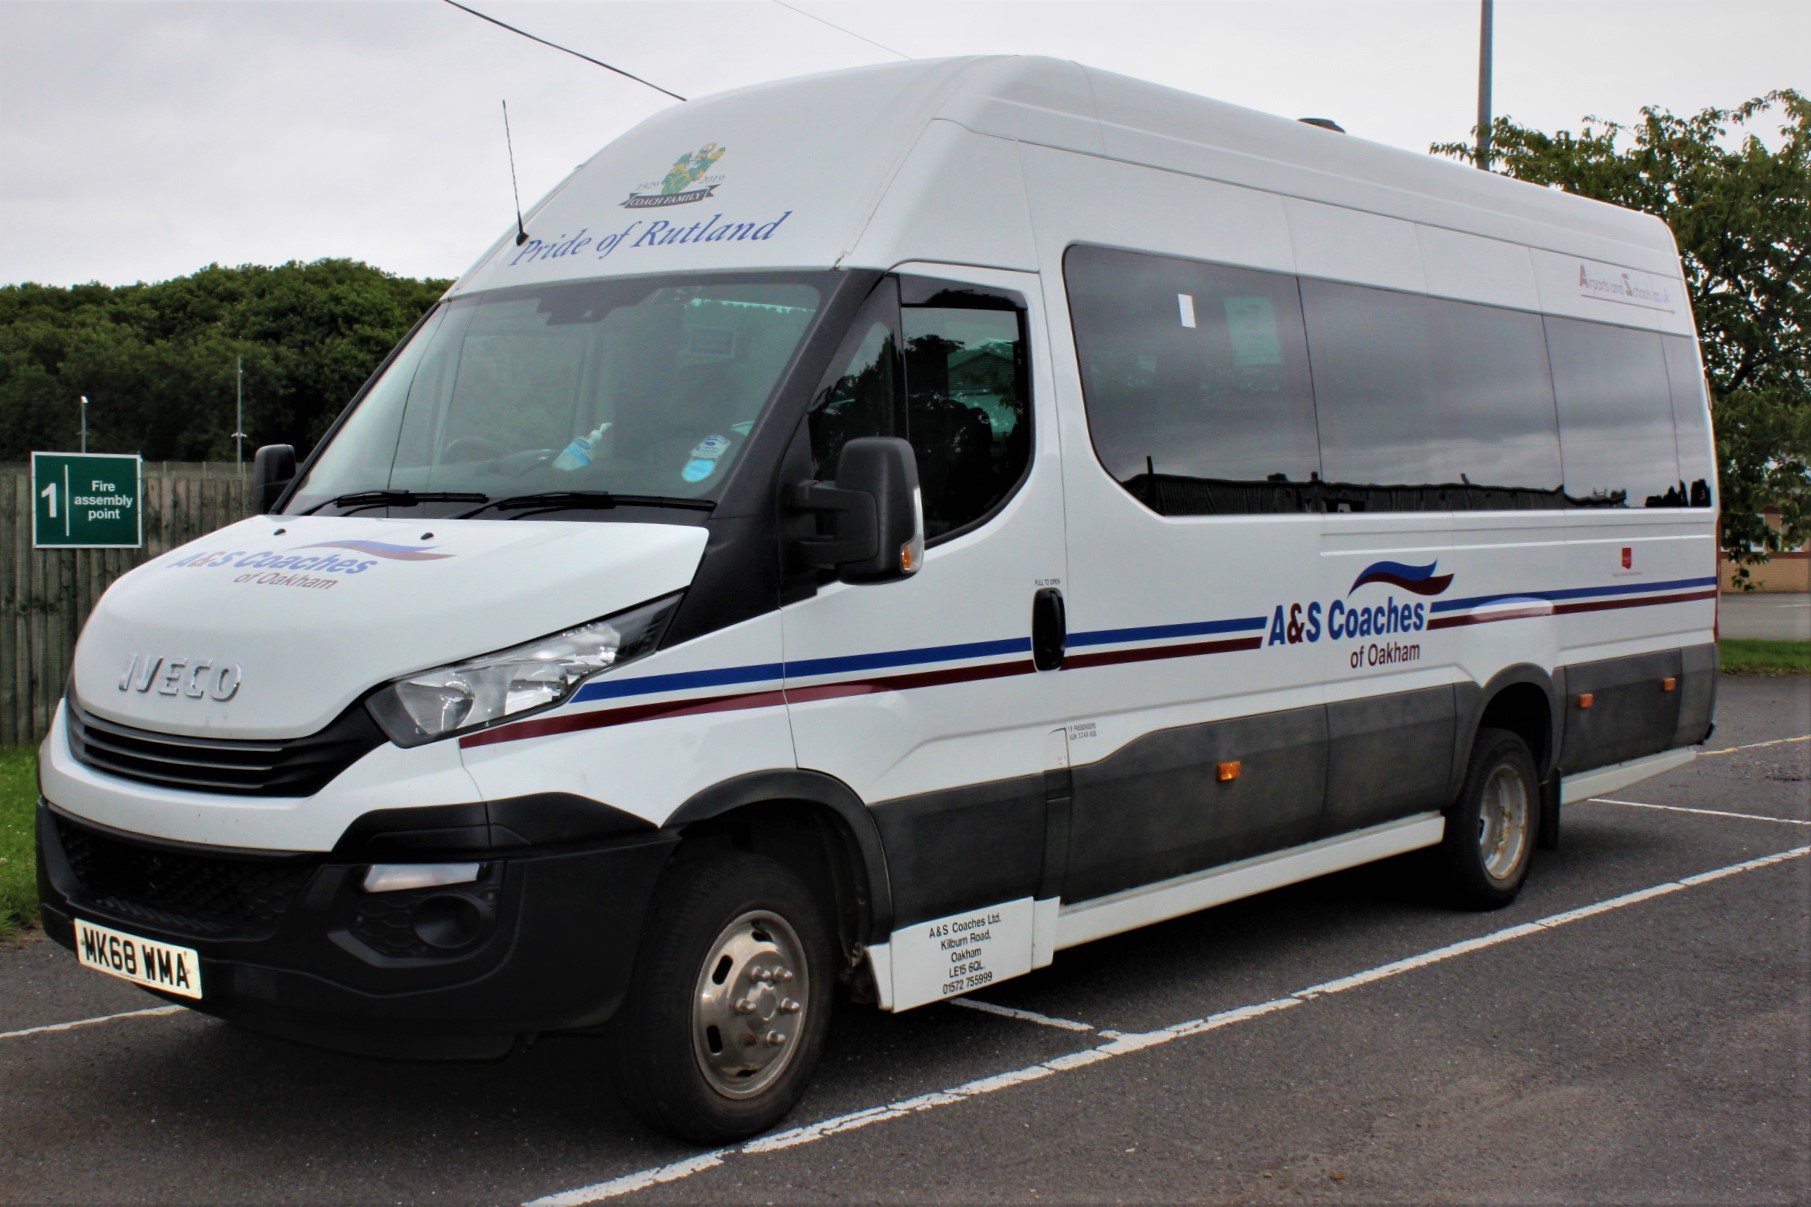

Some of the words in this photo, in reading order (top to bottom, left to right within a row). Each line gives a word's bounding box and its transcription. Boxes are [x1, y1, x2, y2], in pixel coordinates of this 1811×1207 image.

[630, 196, 662, 206] COACH
[663, 192, 702, 204] FAMILY
[508, 228, 591, 267] Pride
[596, 221, 642, 260] of
[631, 211, 793, 248] Rutland
[91, 480, 116, 492] Fire
[41, 483, 57, 518] 1
[74, 494, 133, 508] assembly
[88, 508, 120, 521] point
[166, 550, 245, 568] A&S
[232, 551, 379, 574] Coaches
[233, 572, 257, 584] of
[256, 573, 339, 590] Oakham
[1268, 602, 1322, 646] A&S
[1328, 596, 1425, 640] Coaches
[1350, 643, 1364, 668] of
[1368, 641, 1420, 666] Oakham
[118, 653, 242, 702] IVECO
[952, 917, 985, 934] Coaches
[987, 913, 1001, 925] Ltd.
[941, 936, 968, 950] Kilburn
[970, 929, 991, 944] Road,
[83, 927, 137, 975] MK68
[142, 944, 190, 989] WMA
[951, 947, 982, 963] Oakham
[949, 964, 966, 978] LE15
[943, 979, 964, 994] 01572
[966, 971, 993, 988] 755999
